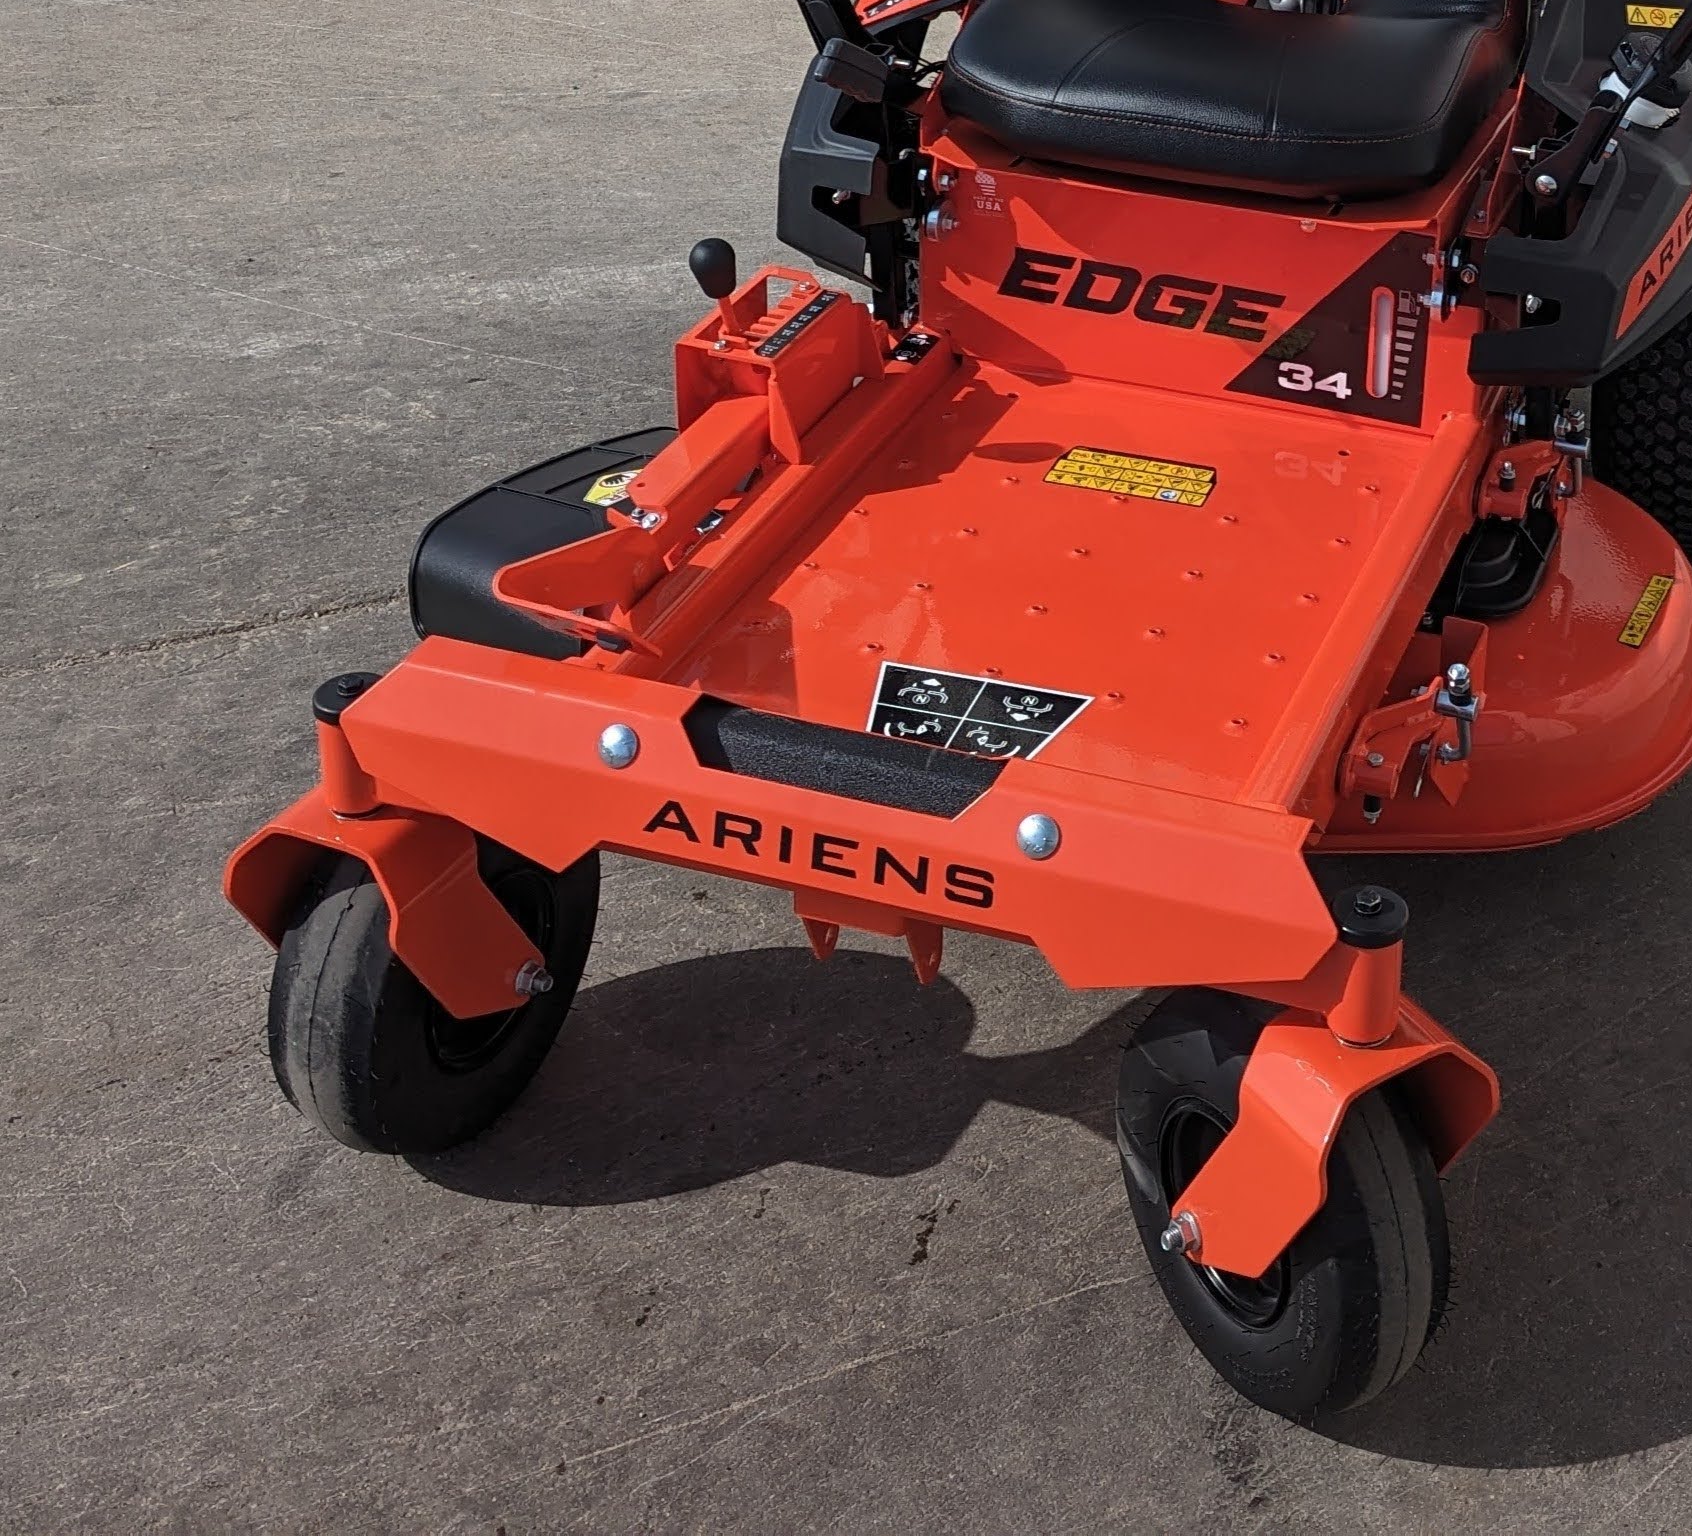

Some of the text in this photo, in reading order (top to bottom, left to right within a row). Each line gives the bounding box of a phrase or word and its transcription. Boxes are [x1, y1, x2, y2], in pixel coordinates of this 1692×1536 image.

[976, 200, 1002, 212] USA
[996, 246, 1287, 343] EDGE
[1277, 362, 1352, 399] 34
[643, 800, 995, 910] ARIENS
